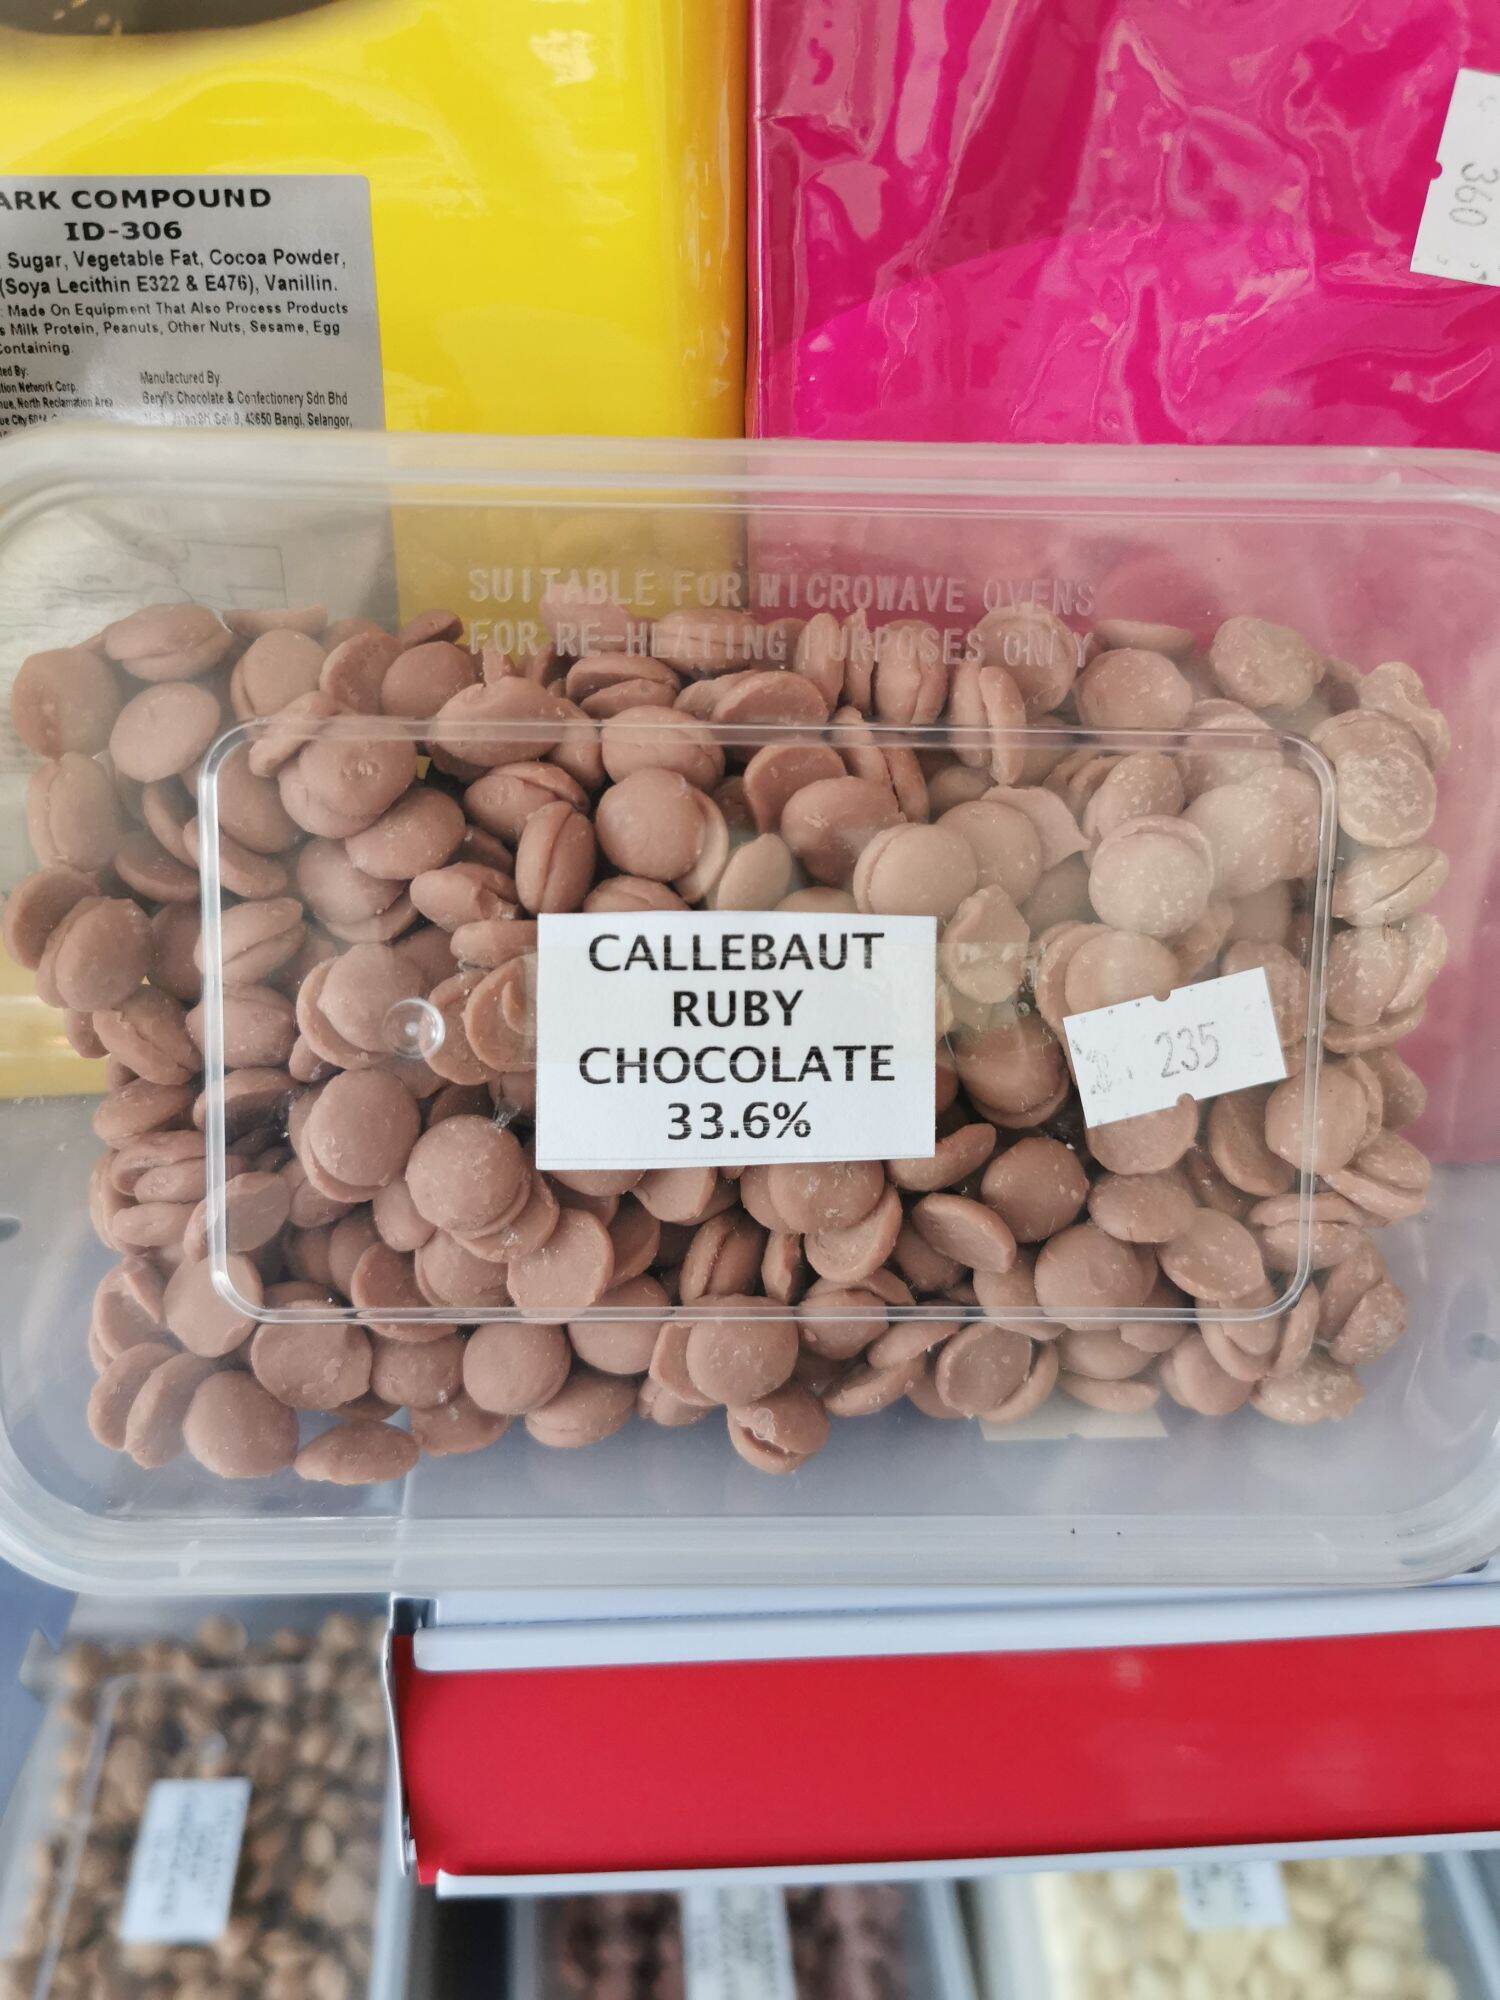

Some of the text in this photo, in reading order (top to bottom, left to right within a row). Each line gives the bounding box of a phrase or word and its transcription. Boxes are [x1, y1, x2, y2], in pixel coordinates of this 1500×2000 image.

[71, 188, 272, 209] COMPOUND
[1449, 162, 1499, 227] 360
[64, 220, 182, 241] ID-306
[7, 248, 346, 273] Sugar, Vegetable Fat, Cocoa Powder,
[57, 276, 131, 294] Lecithin
[137, 275, 180, 293] E322
[187, 275, 198, 292] &
[205, 274, 260, 296] E476),
[265, 274, 338, 292] Vanillin.
[8, 301, 349, 318] Made On Equipment That Also Process Products
[10, 322, 39, 336] Milk
[44, 322, 99, 336] Protein,
[104, 321, 163, 335] Peanuts,
[168, 320, 206, 334] Other
[210, 320, 246, 335] Nuts,
[250, 320, 310, 335] Sesame,
[313, 320, 340, 335] Egg
[19, 381, 54, 394] Network
[140, 371, 204, 385] Manufactured
[178, 390, 225, 405] Chocolate
[228, 390, 234, 404] &
[238, 390, 304, 408] Confectionery
[306, 391, 326, 405] Sdn
[328, 391, 348, 405] Bhd
[307, 413, 352, 429] Selangor,
[468, 567, 1096, 616] SUITABLE FOR MICROWAVE OVENS
[470, 617, 539, 656] FOR
[588, 932, 884, 972] CALLEBAUT
[672, 988, 804, 1028] RUBY
[1154, 1020, 1220, 1078] 235
[578, 1044, 896, 1085] CHOCOLATE
[667, 1101, 811, 1140] 33.6%
